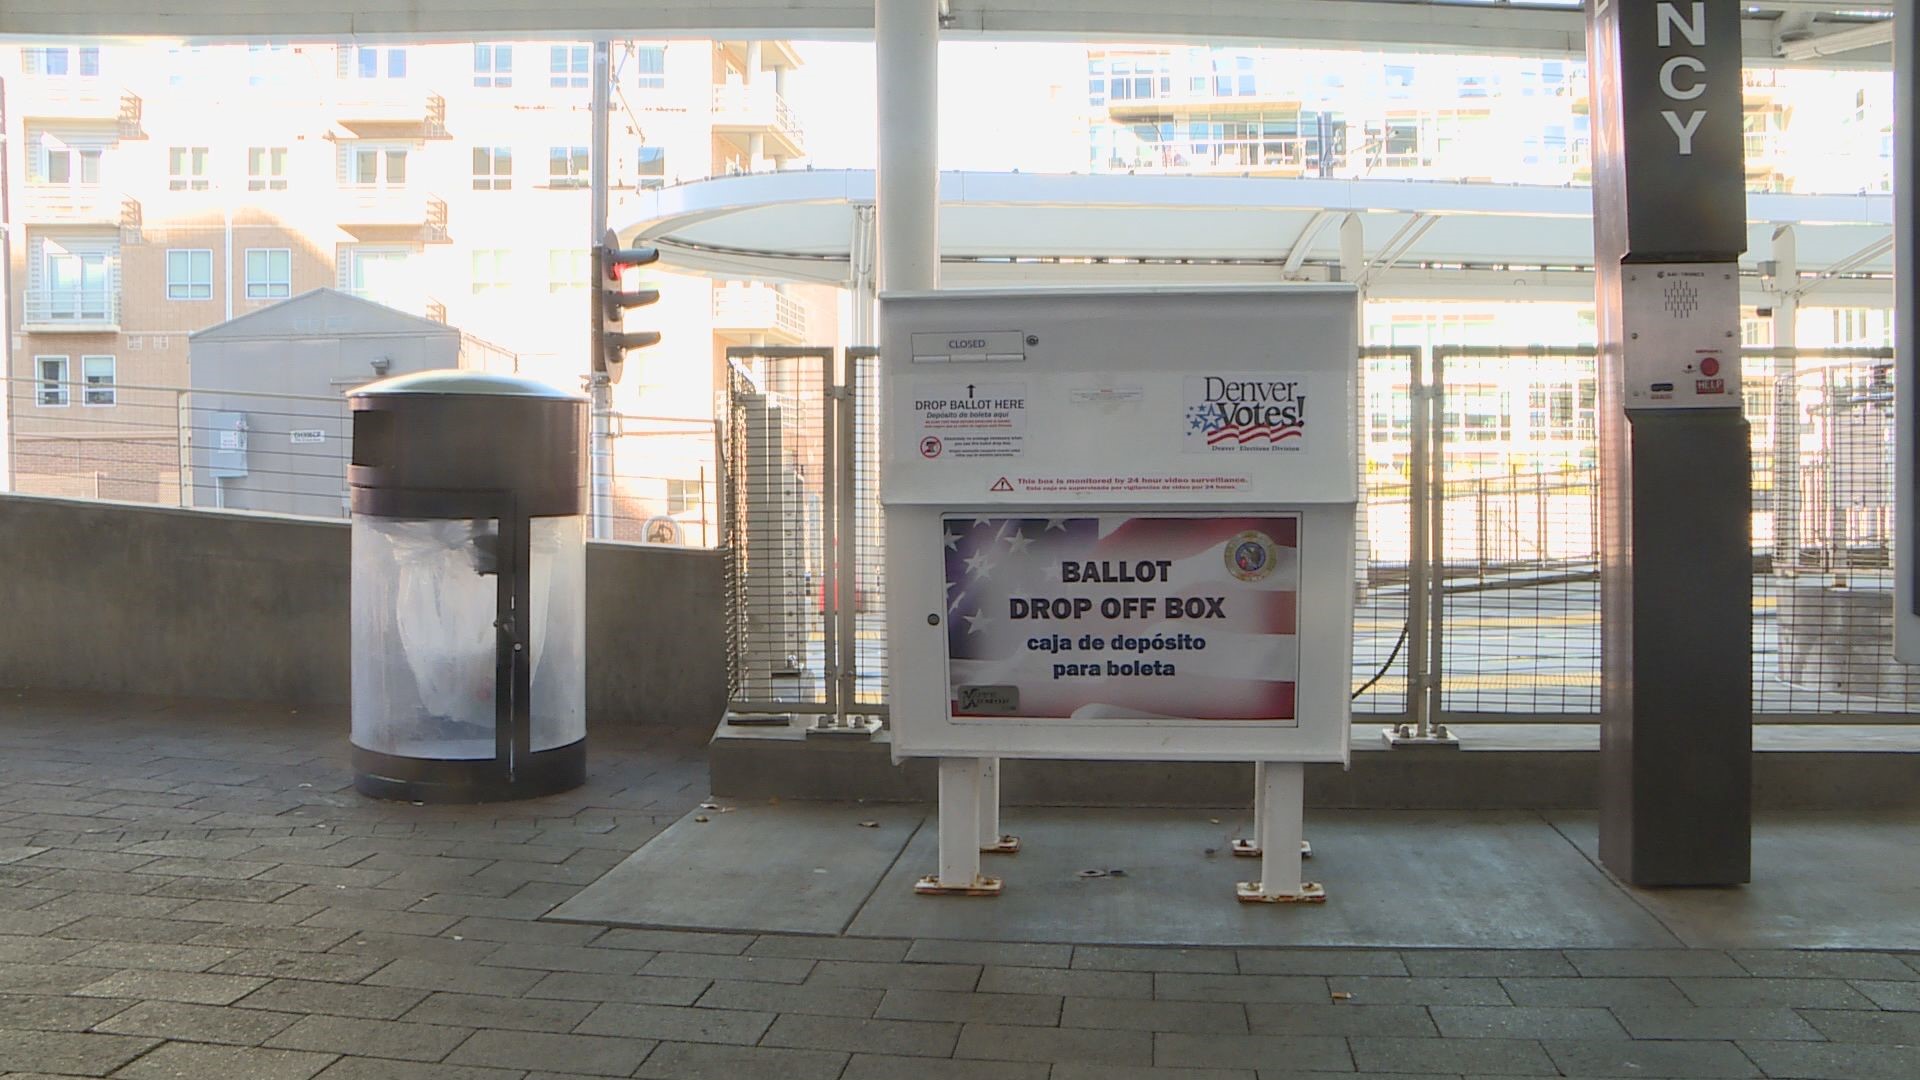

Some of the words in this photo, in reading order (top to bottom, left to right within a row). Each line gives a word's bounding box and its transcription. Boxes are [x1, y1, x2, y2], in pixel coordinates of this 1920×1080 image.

[948, 339, 986, 349] CLOSED
[1203, 376, 1298, 402] Denver
[915, 400, 947, 411] DROP
[950, 399, 991, 410] BALLOT
[994, 399, 1025, 409] HERE
[1216, 396, 1306, 427] Votes!
[1114, 477, 1124, 485] by
[1061, 560, 1172, 583] BALLOT
[1009, 597, 1092, 620] DROP
[1100, 597, 1156, 619] OFF
[1164, 597, 1226, 619] BOX
[1027, 634, 1072, 654] caja
[1078, 634, 1105, 651] de
[1110, 633, 1206, 654] depósito
[1053, 662, 1101, 680] para
[1107, 660, 1176, 677] boleta
